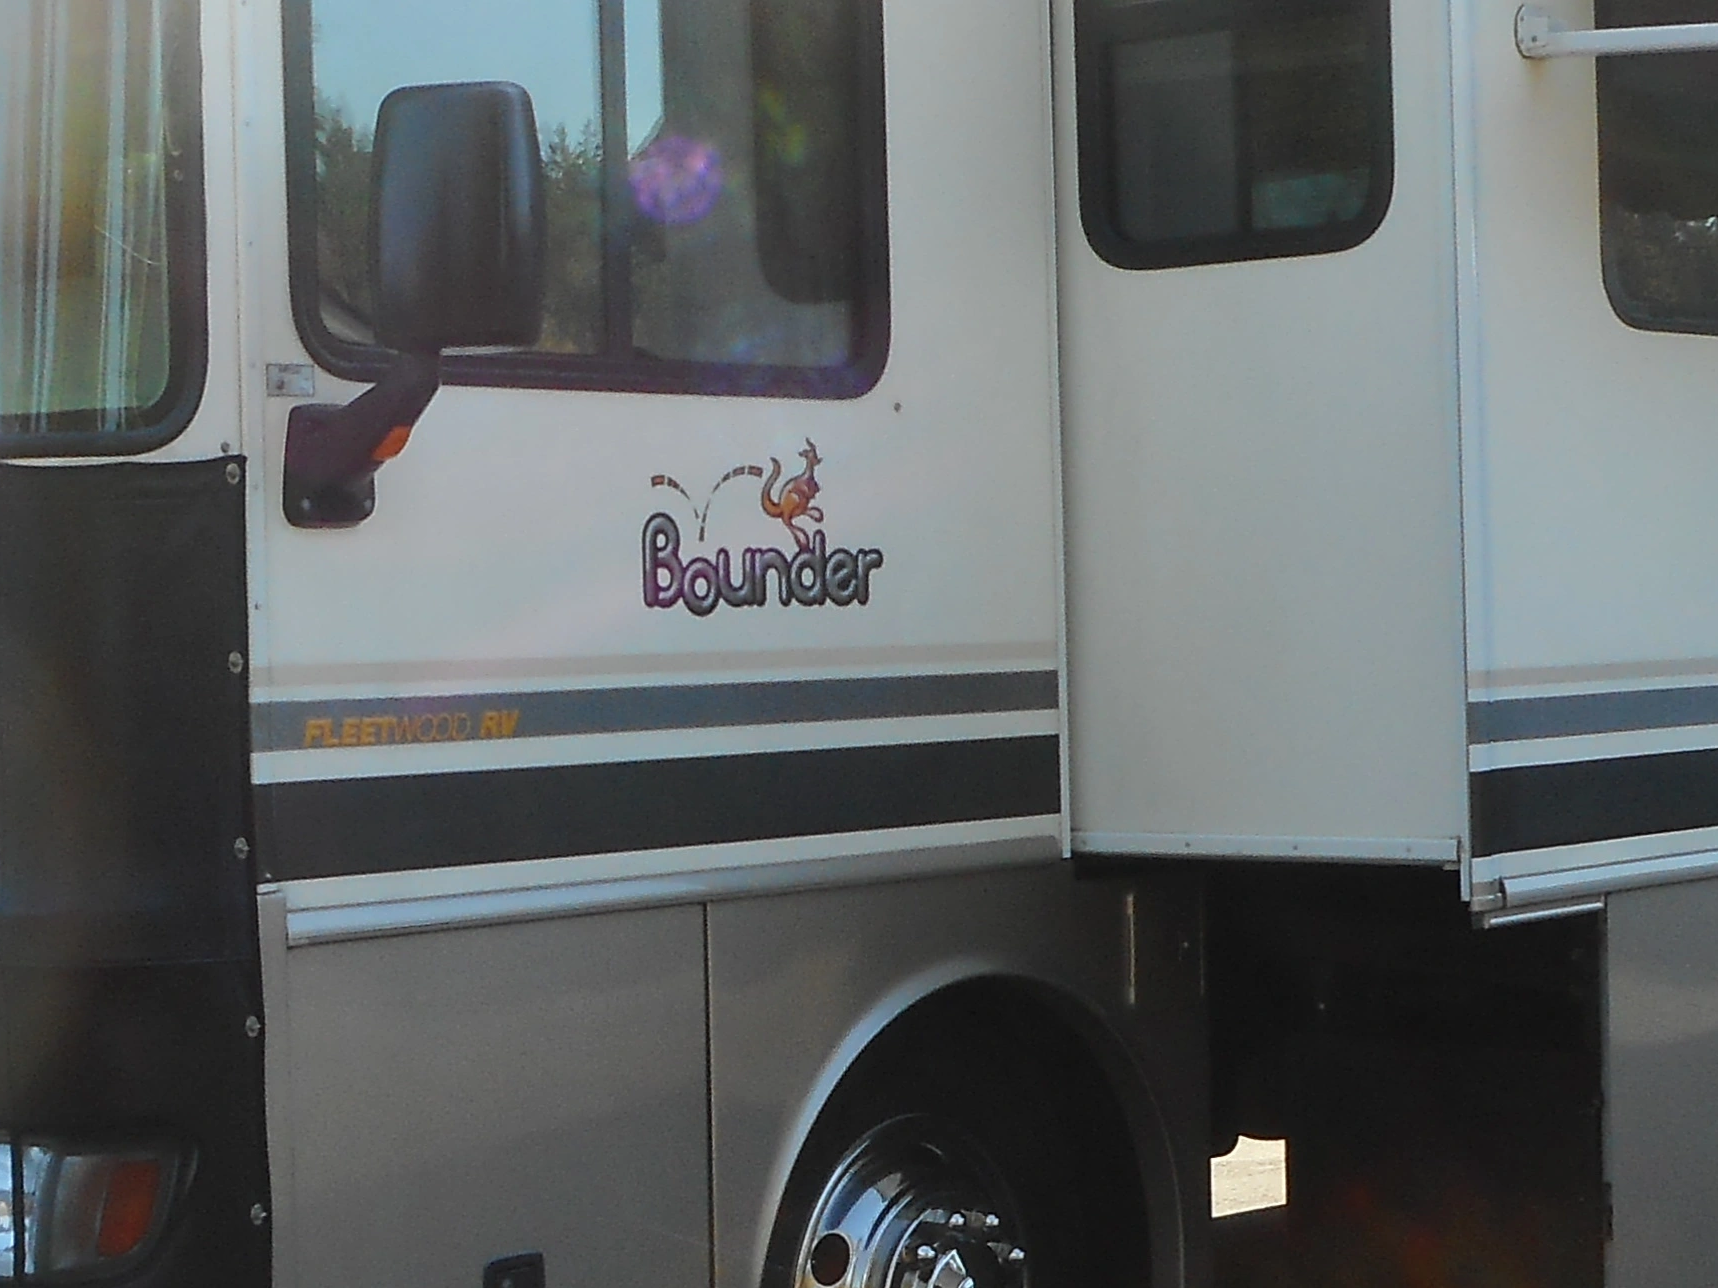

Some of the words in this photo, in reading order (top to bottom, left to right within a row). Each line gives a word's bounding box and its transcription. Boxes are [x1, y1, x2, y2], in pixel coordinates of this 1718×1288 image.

[641, 512, 884, 617] Bounder
[304, 713, 471, 748] FLEETWOOD
[479, 710, 520, 740] RV
